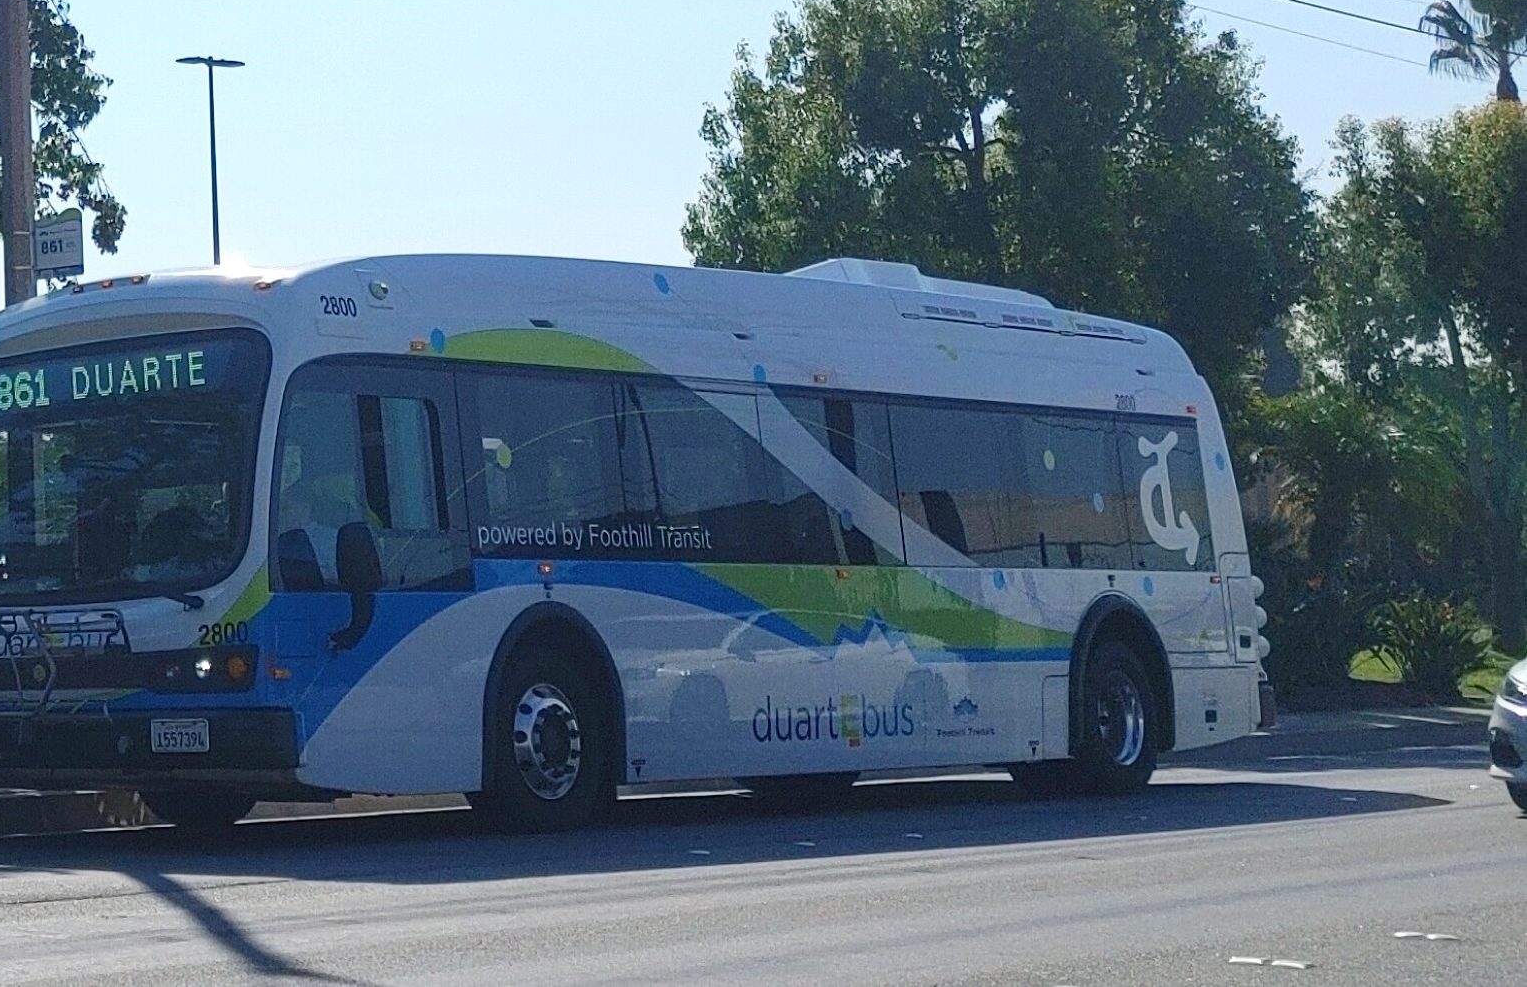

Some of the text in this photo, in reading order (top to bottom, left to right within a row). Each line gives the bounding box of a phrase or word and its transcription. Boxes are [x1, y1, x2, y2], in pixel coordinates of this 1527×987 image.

[41, 239, 63, 255] 861
[319, 295, 358, 318] 2800
[72, 350, 206, 401] DUARTE
[477, 521, 713, 551] powered by Foothill Transit
[198, 620, 249, 646] 2800
